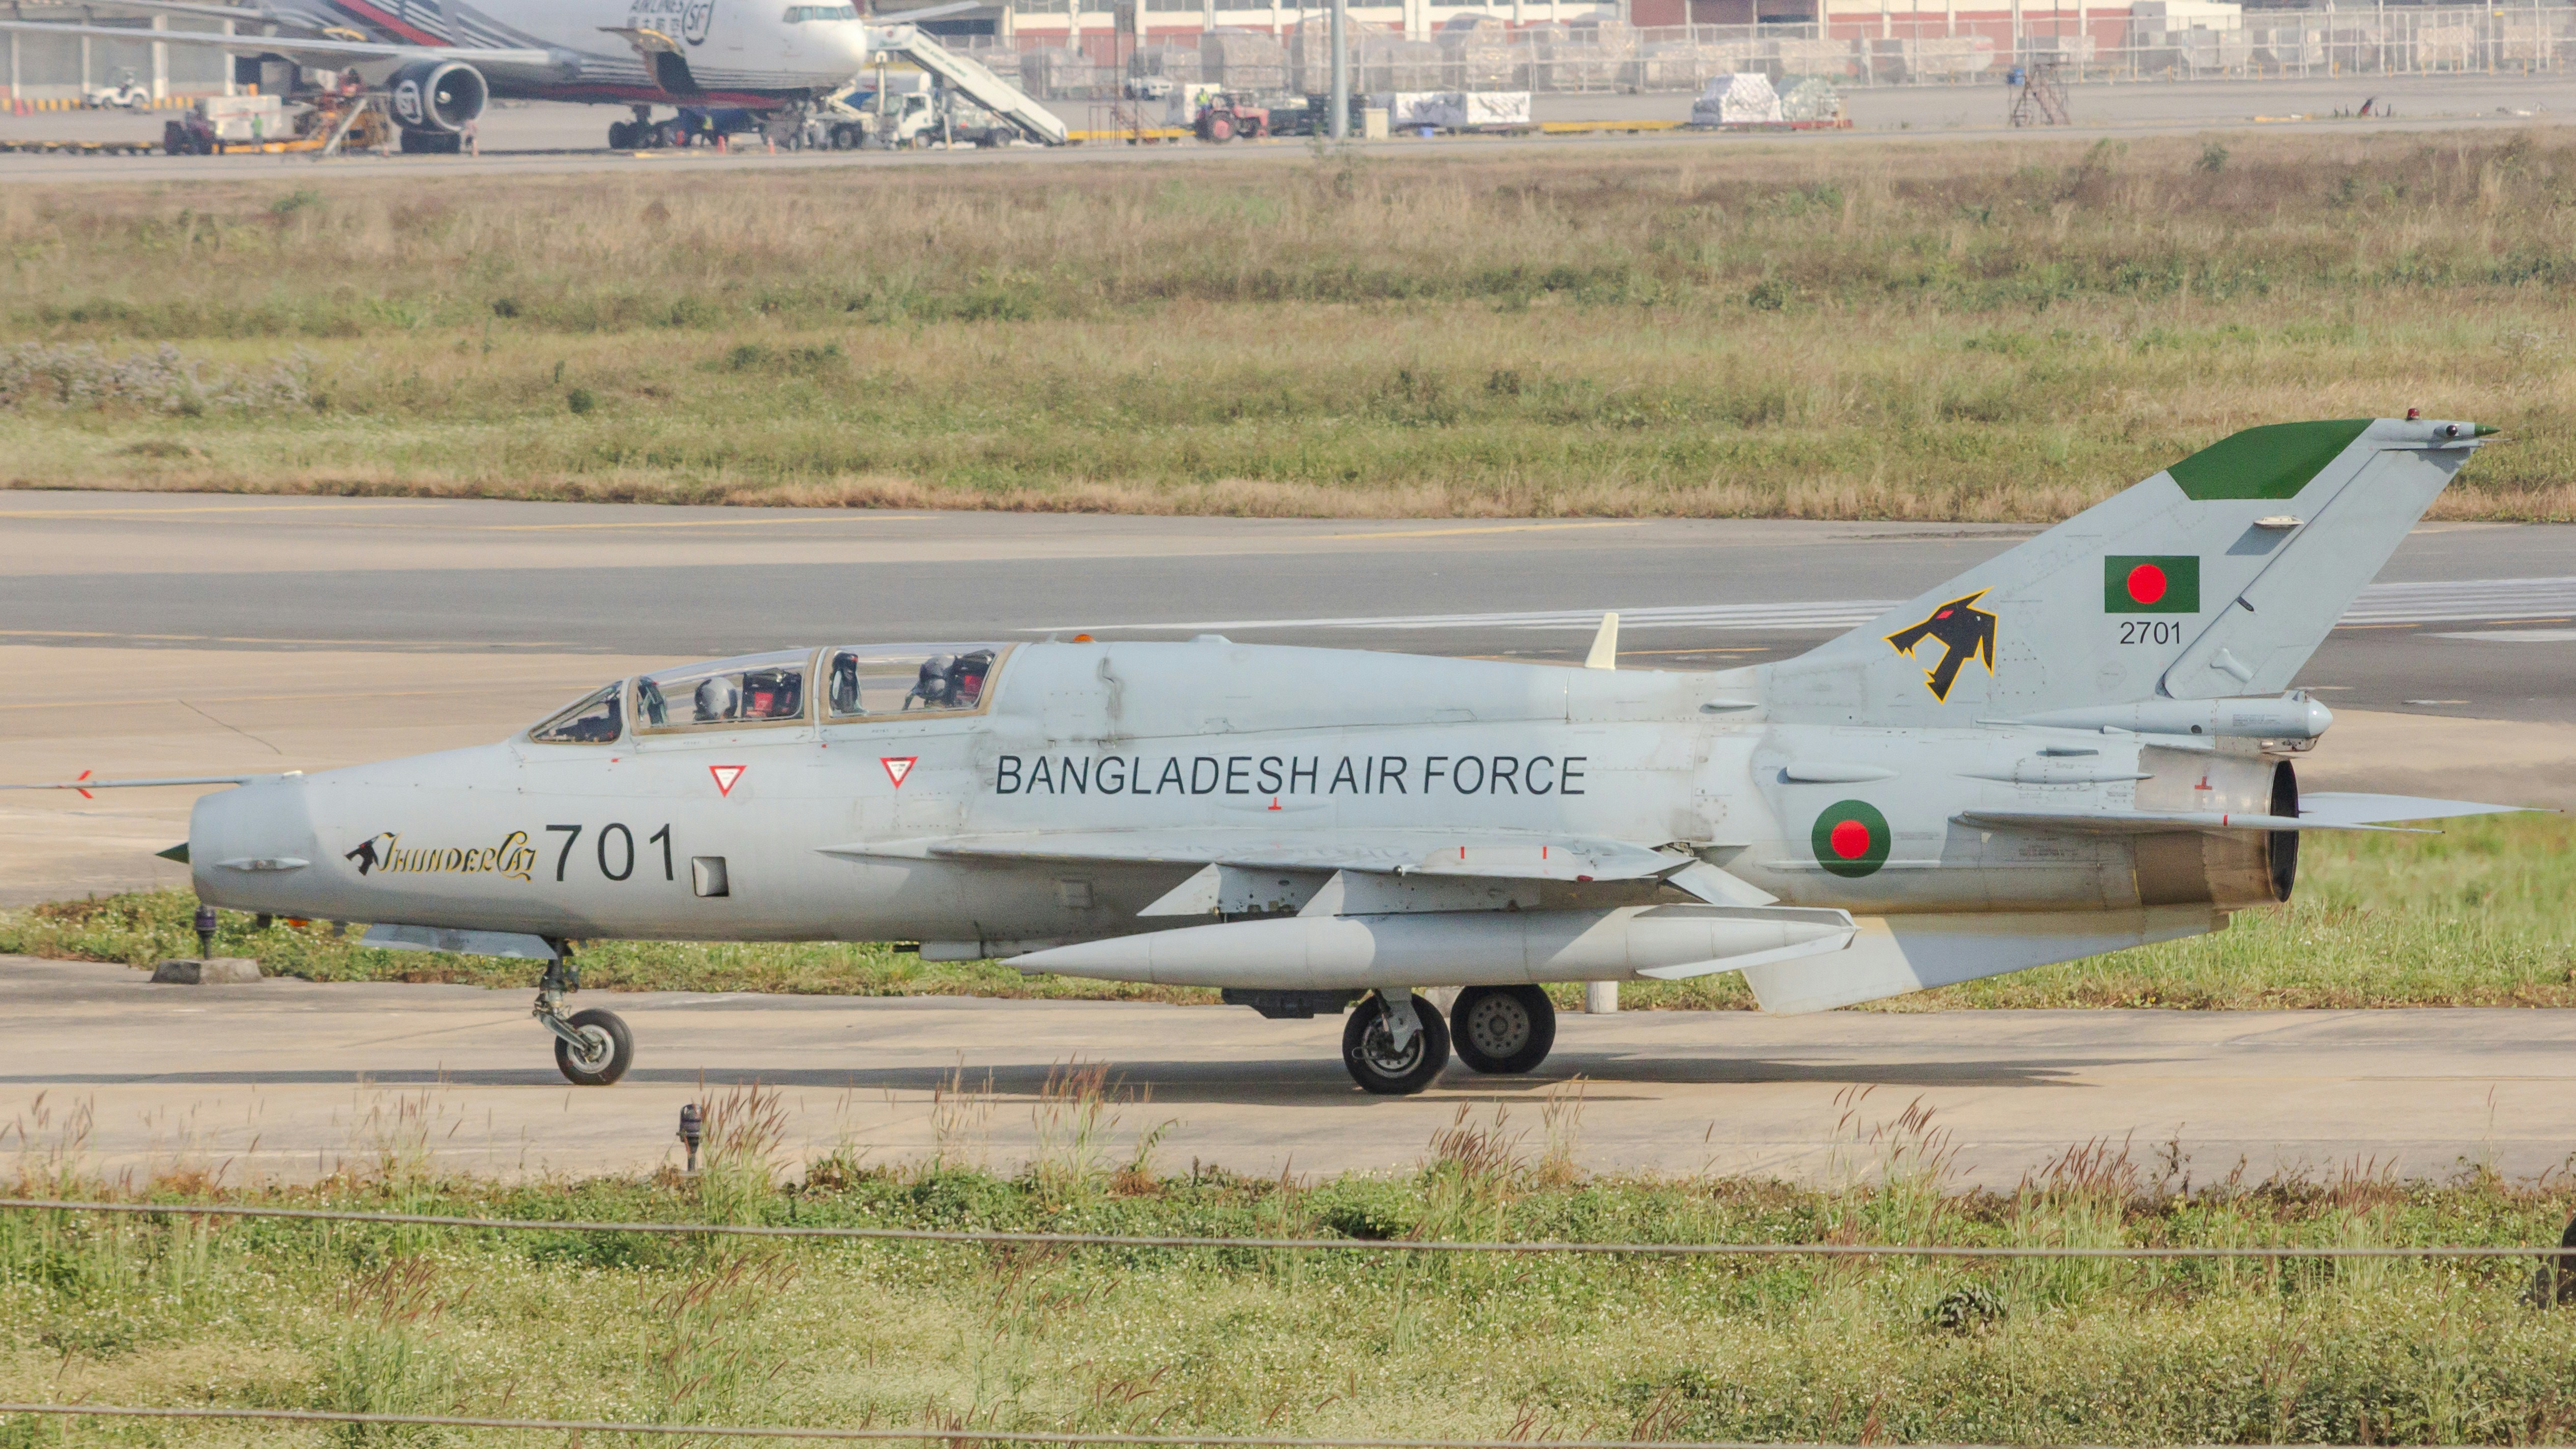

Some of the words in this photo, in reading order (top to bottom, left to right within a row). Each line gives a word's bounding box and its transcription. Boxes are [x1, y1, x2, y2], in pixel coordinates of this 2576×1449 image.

[2120, 622, 2180, 644] 2701
[997, 755, 1319, 795] BANGLADESH
[1329, 756, 1407, 794] AIR
[1424, 756, 1587, 795] FORCE
[546, 823, 674, 882] 701
